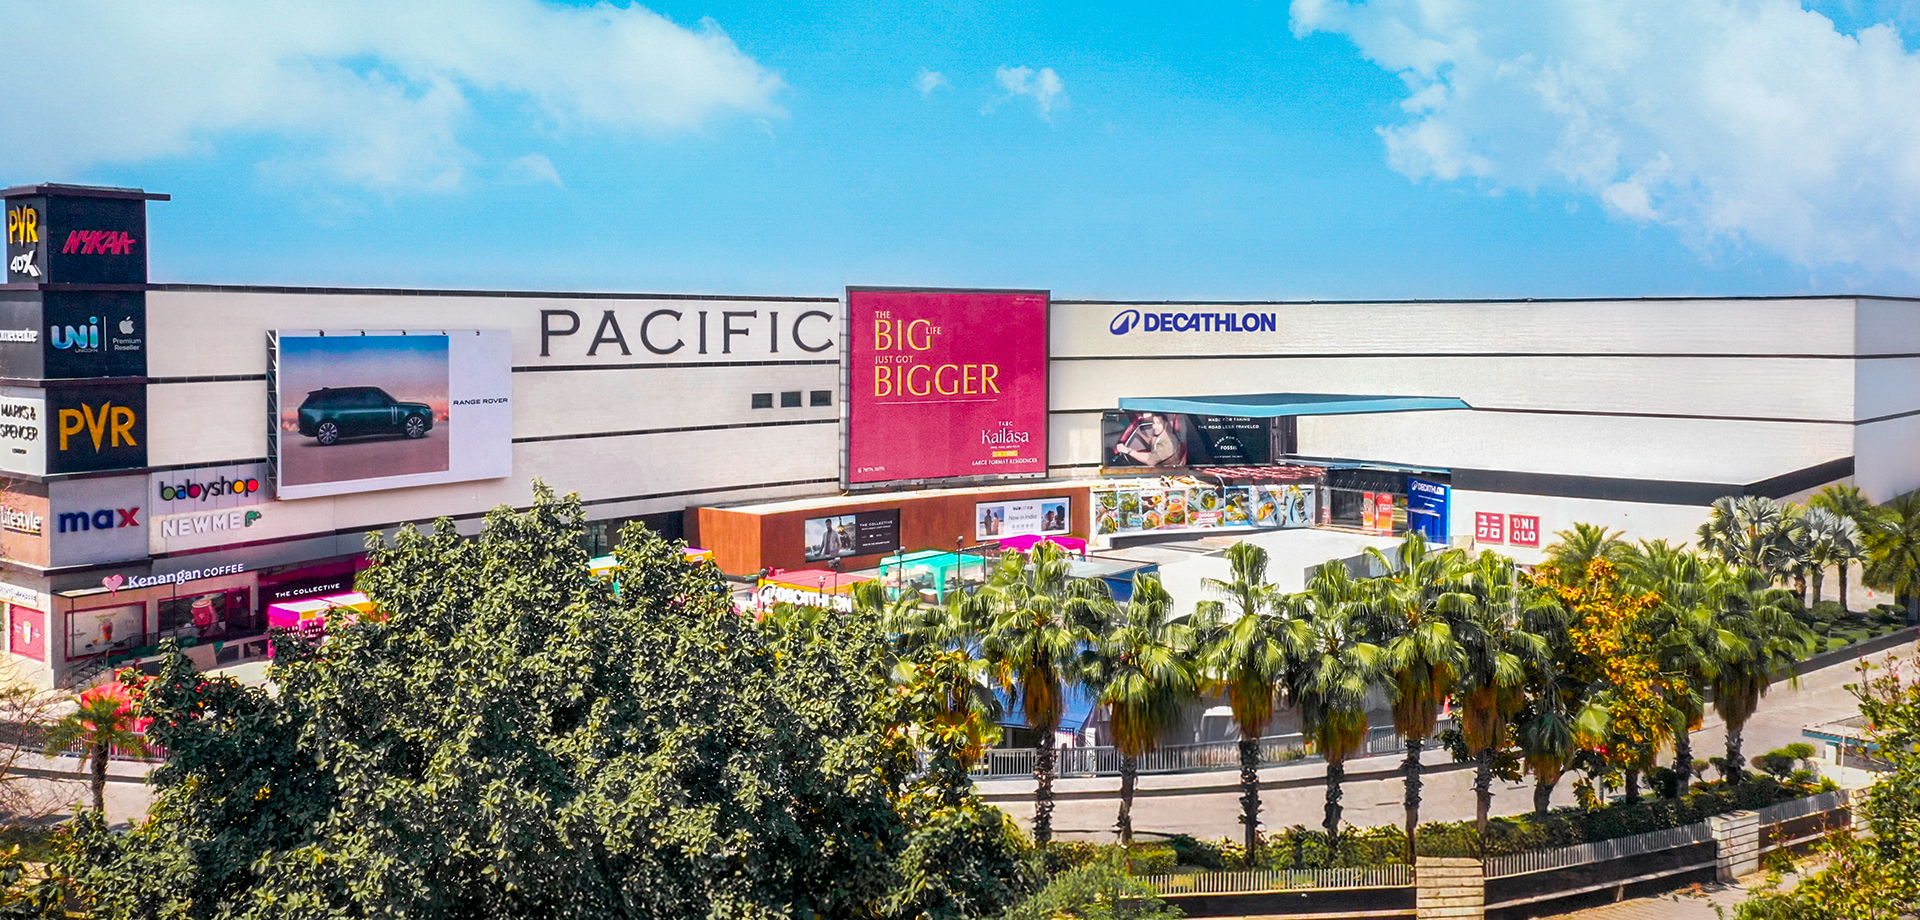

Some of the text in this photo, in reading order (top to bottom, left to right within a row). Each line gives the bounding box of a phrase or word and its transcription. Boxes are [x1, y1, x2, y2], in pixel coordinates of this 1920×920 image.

[9, 204, 39, 247] PVR
[62, 230, 137, 255] NYKAA
[10, 250, 42, 277] 4DX
[875, 311, 891, 319] THE
[1144, 313, 1277, 332] DECATHLON
[540, 309, 834, 356] PACIFIC
[875, 319, 931, 350] BIG
[875, 355, 913, 364] JUST GOT
[875, 364, 1000, 396] BIGGER
[30, 406, 36, 420] &
[58, 401, 137, 454] PVR
[160, 476, 259, 501] babyshop
[59, 507, 140, 533] max
[161, 512, 241, 538] NEWME
[1512, 518, 1535, 530] UNI
[1513, 530, 1536, 543] QLO
[128, 563, 244, 589] Kenangan COFFEE
[293, 583, 340, 596] COLLECTIVE
[776, 586, 853, 613] DECATHON
